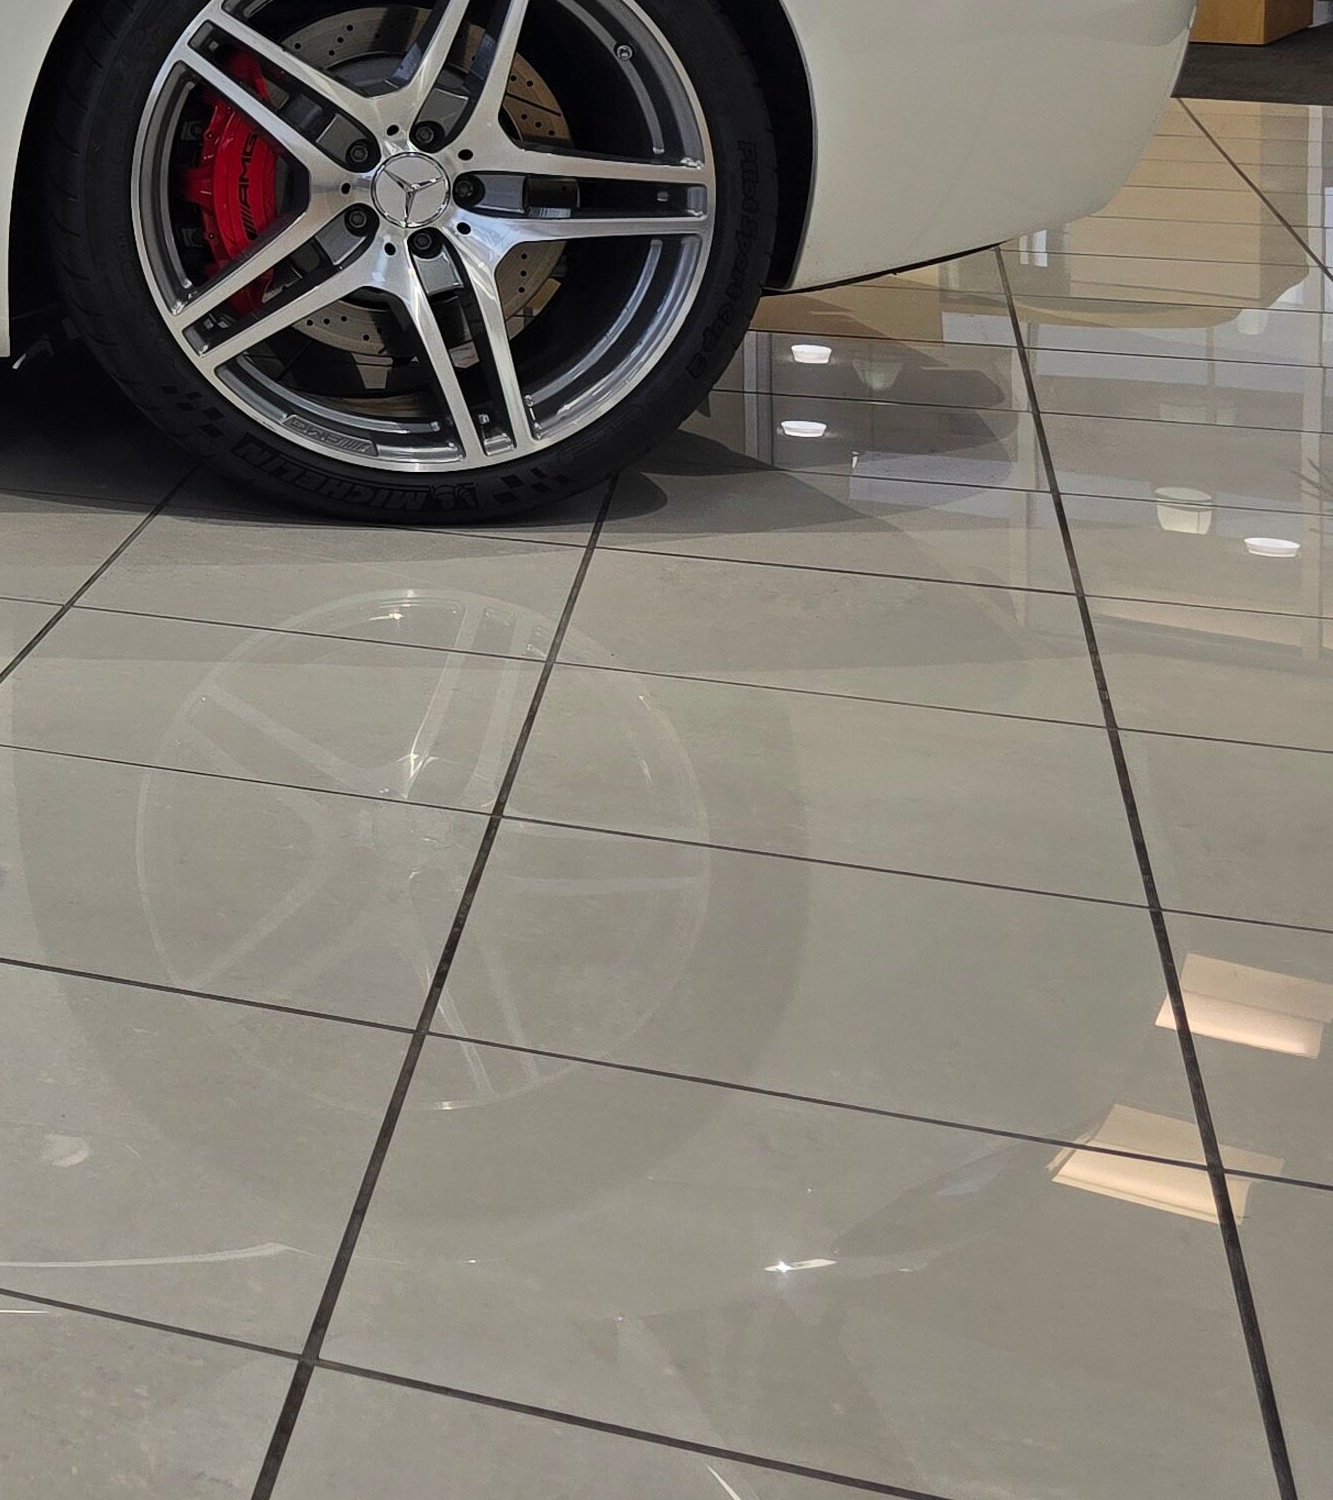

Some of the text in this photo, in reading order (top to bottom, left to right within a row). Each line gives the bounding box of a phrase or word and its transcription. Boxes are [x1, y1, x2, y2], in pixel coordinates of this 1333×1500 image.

[724, 216, 760, 302] Sport
[701, 302, 736, 353] Cup
[232, 441, 427, 511] MICHELIN
